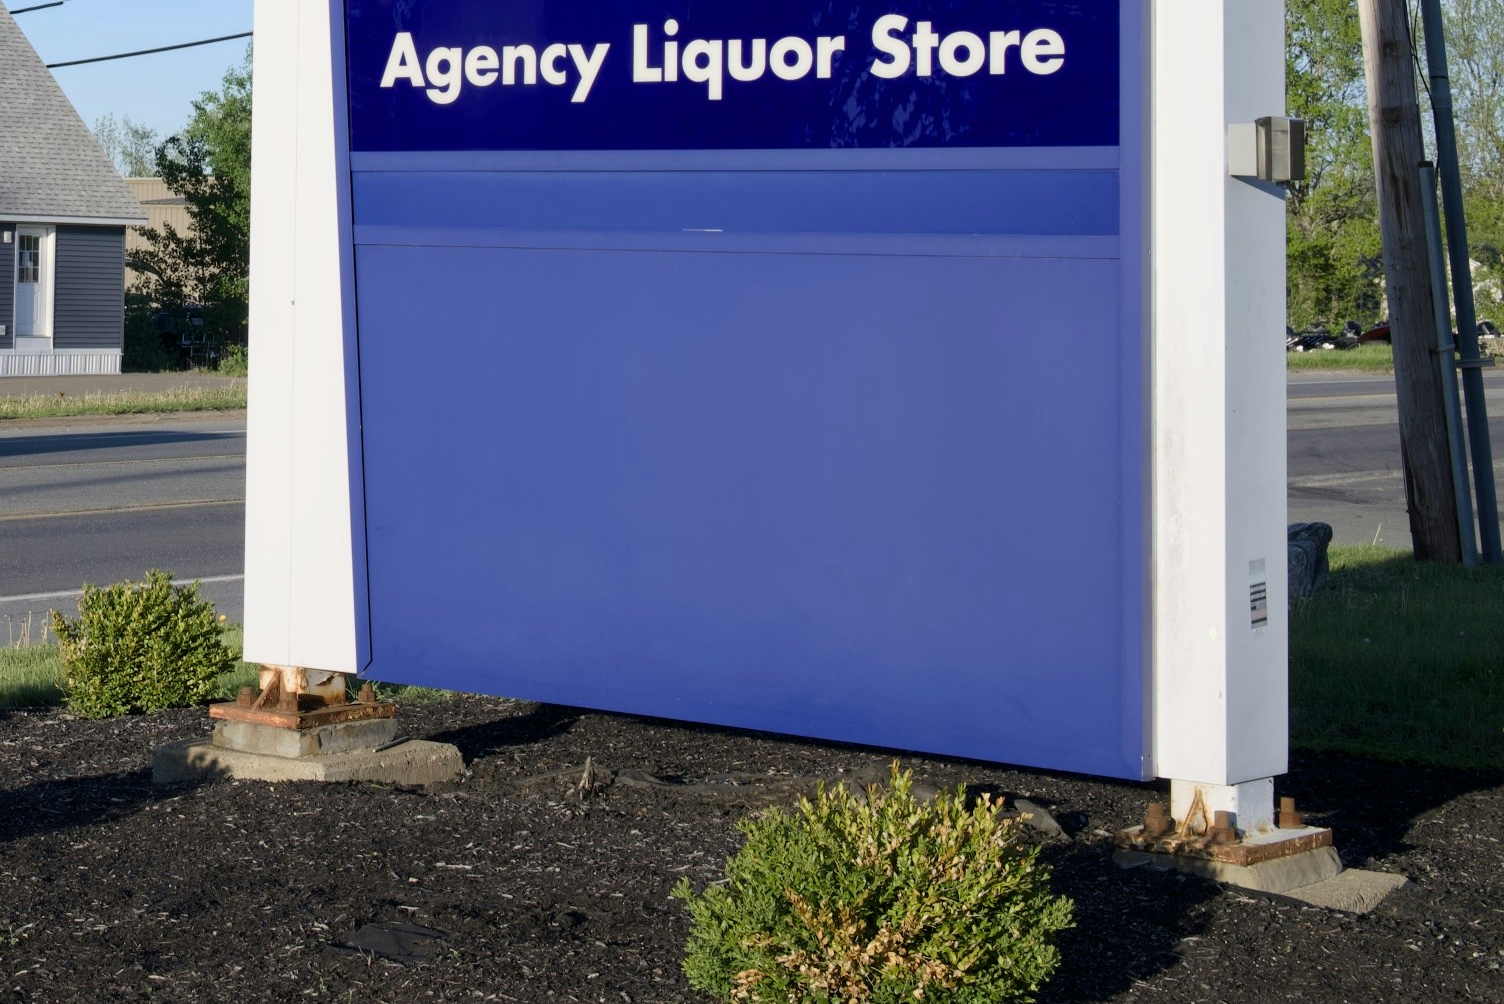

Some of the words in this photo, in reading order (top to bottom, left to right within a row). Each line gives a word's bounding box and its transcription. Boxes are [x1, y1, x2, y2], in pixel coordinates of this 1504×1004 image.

[380, 32, 610, 104] Agency
[633, 19, 845, 100] Liquor
[870, 14, 1065, 79] Store
